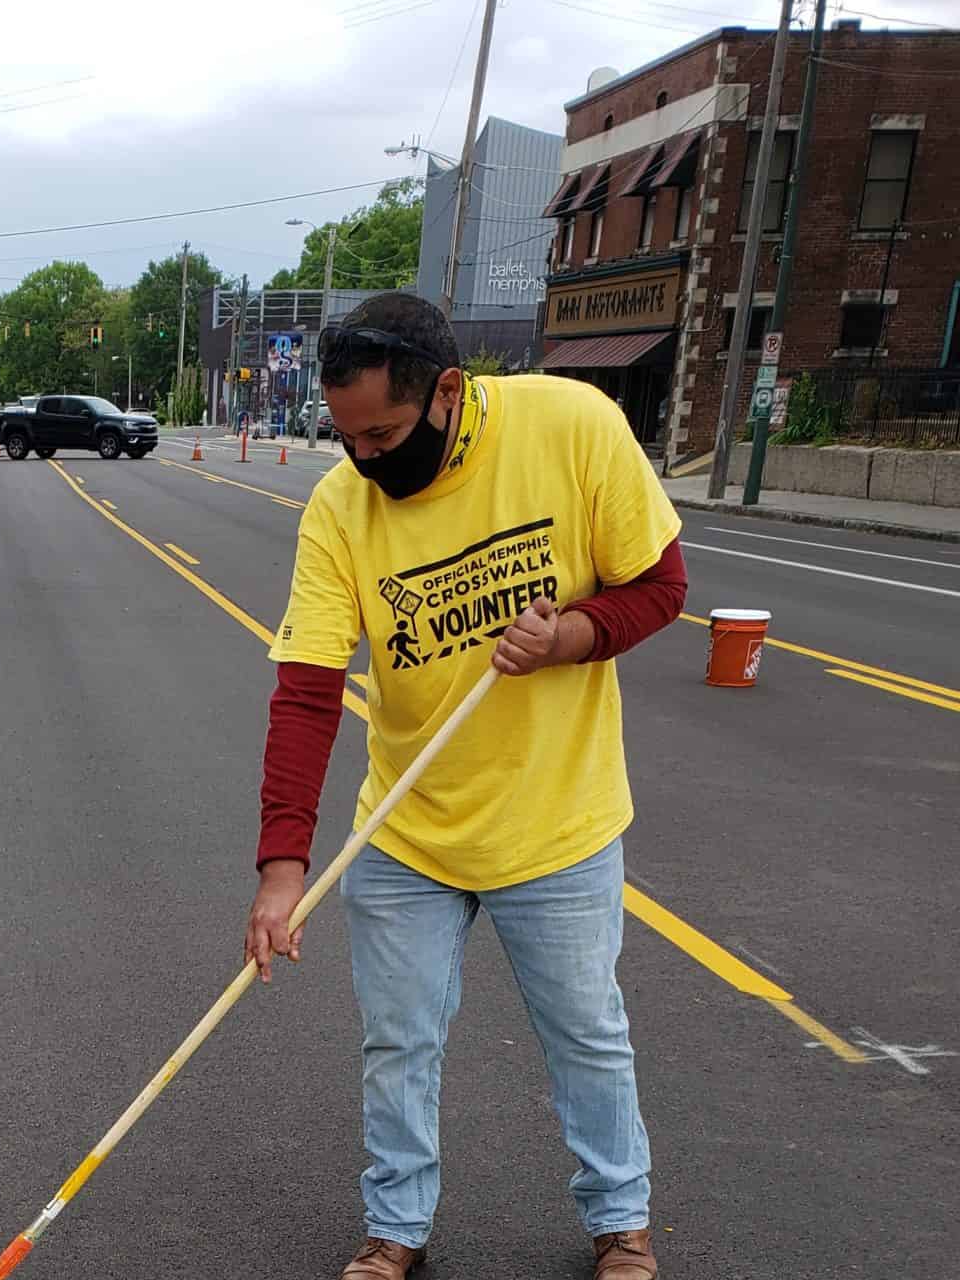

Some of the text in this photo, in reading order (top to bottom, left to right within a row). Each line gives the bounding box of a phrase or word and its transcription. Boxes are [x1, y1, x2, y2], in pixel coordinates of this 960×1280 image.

[488, 272, 546, 295] memphis
[584, 282, 667, 320] RISTORANTE
[422, 535, 550, 590] OFFICIAL MEMPHIS
[426, 550, 554, 609] CROSSWALK
[428, 575, 558, 643] VOLUNTEER
